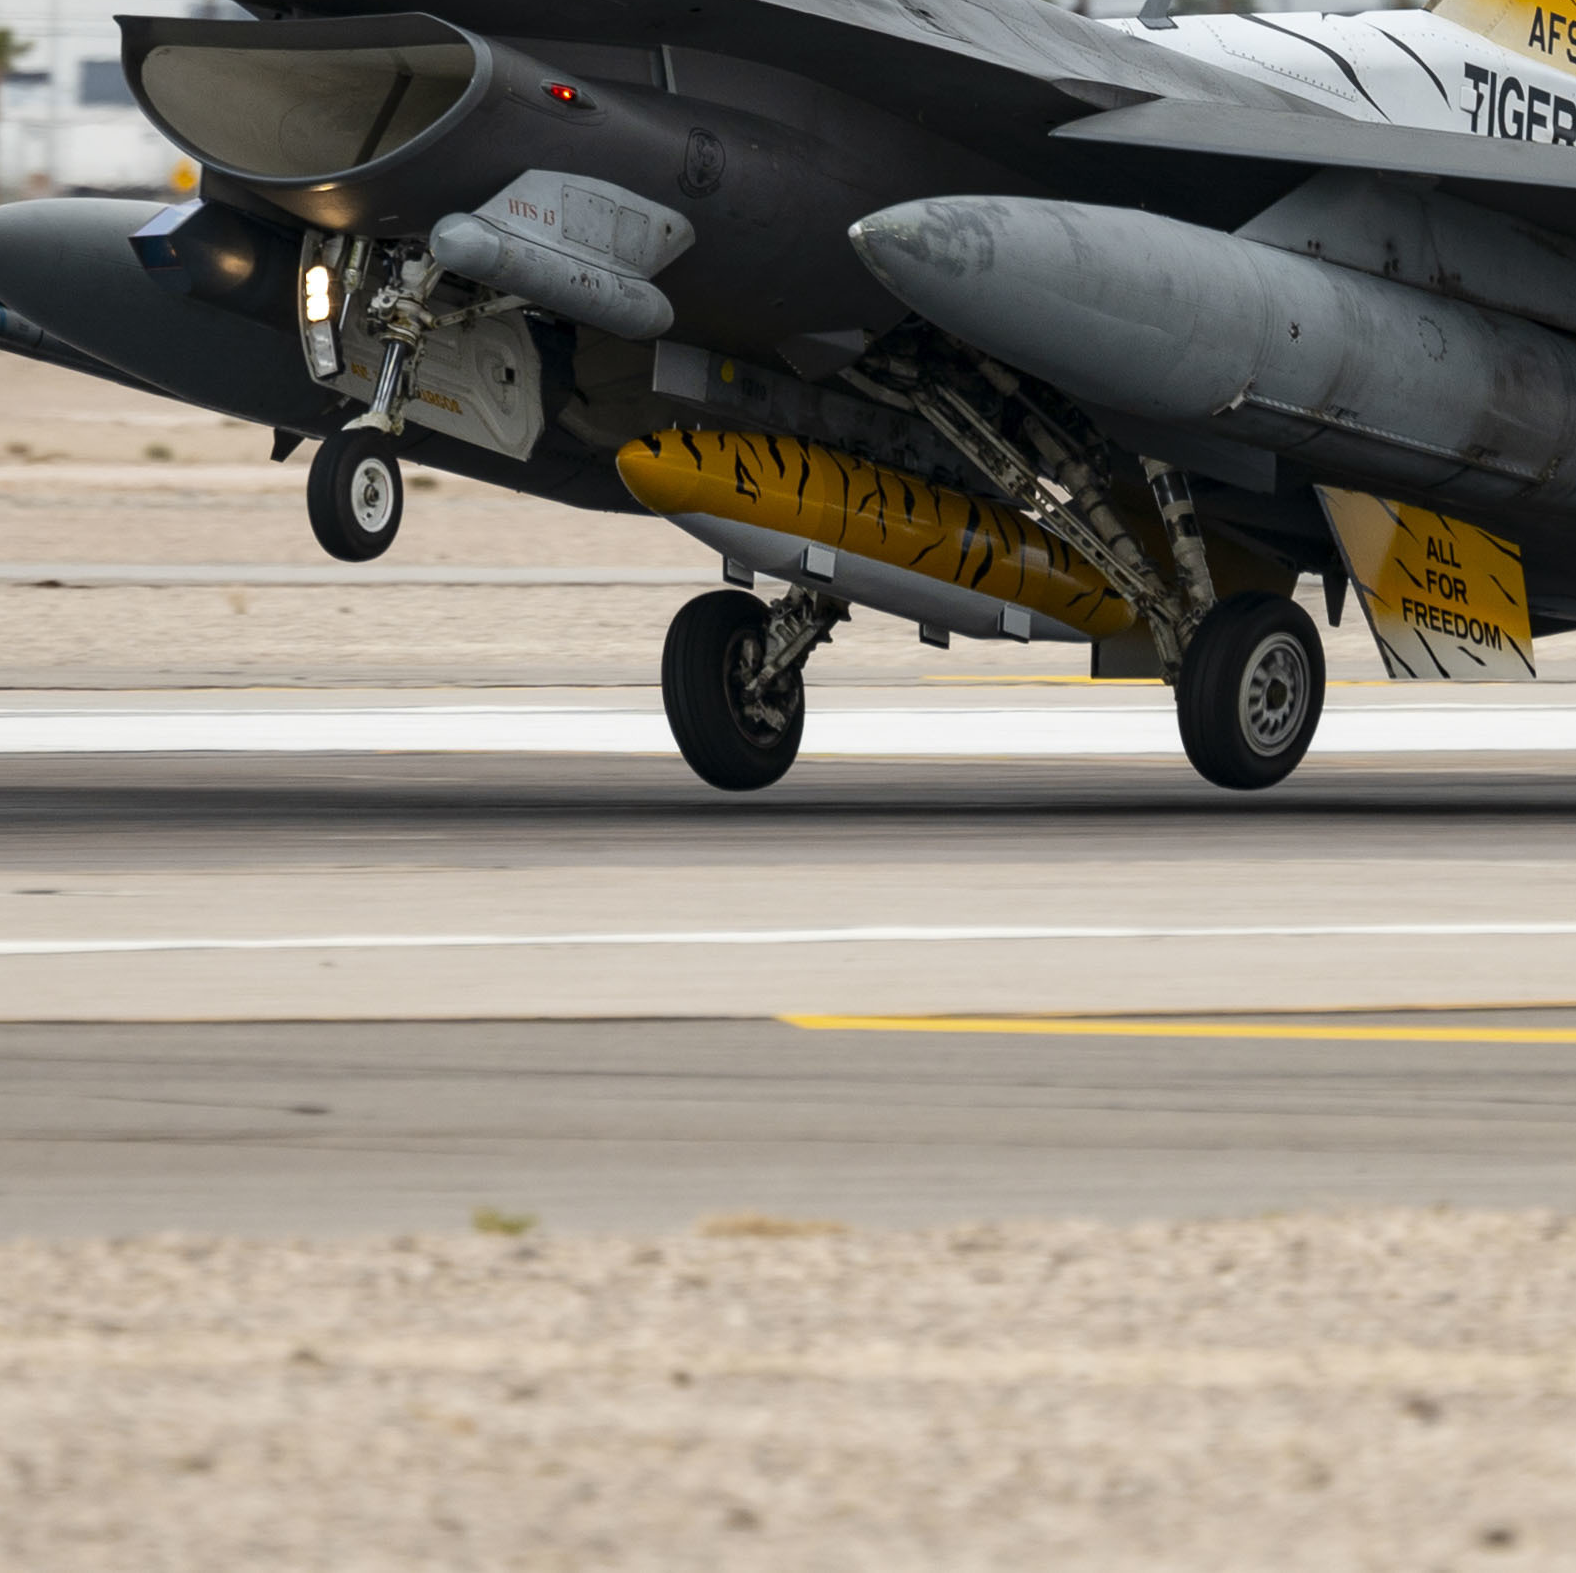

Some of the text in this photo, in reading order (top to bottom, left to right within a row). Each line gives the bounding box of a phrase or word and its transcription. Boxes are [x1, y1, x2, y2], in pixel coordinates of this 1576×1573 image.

[508, 198, 538, 220] HTS
[1426, 535, 1462, 569] ALL
[1426, 568, 1469, 605] FOR
[1402, 597, 1502, 651] FREEDOM
